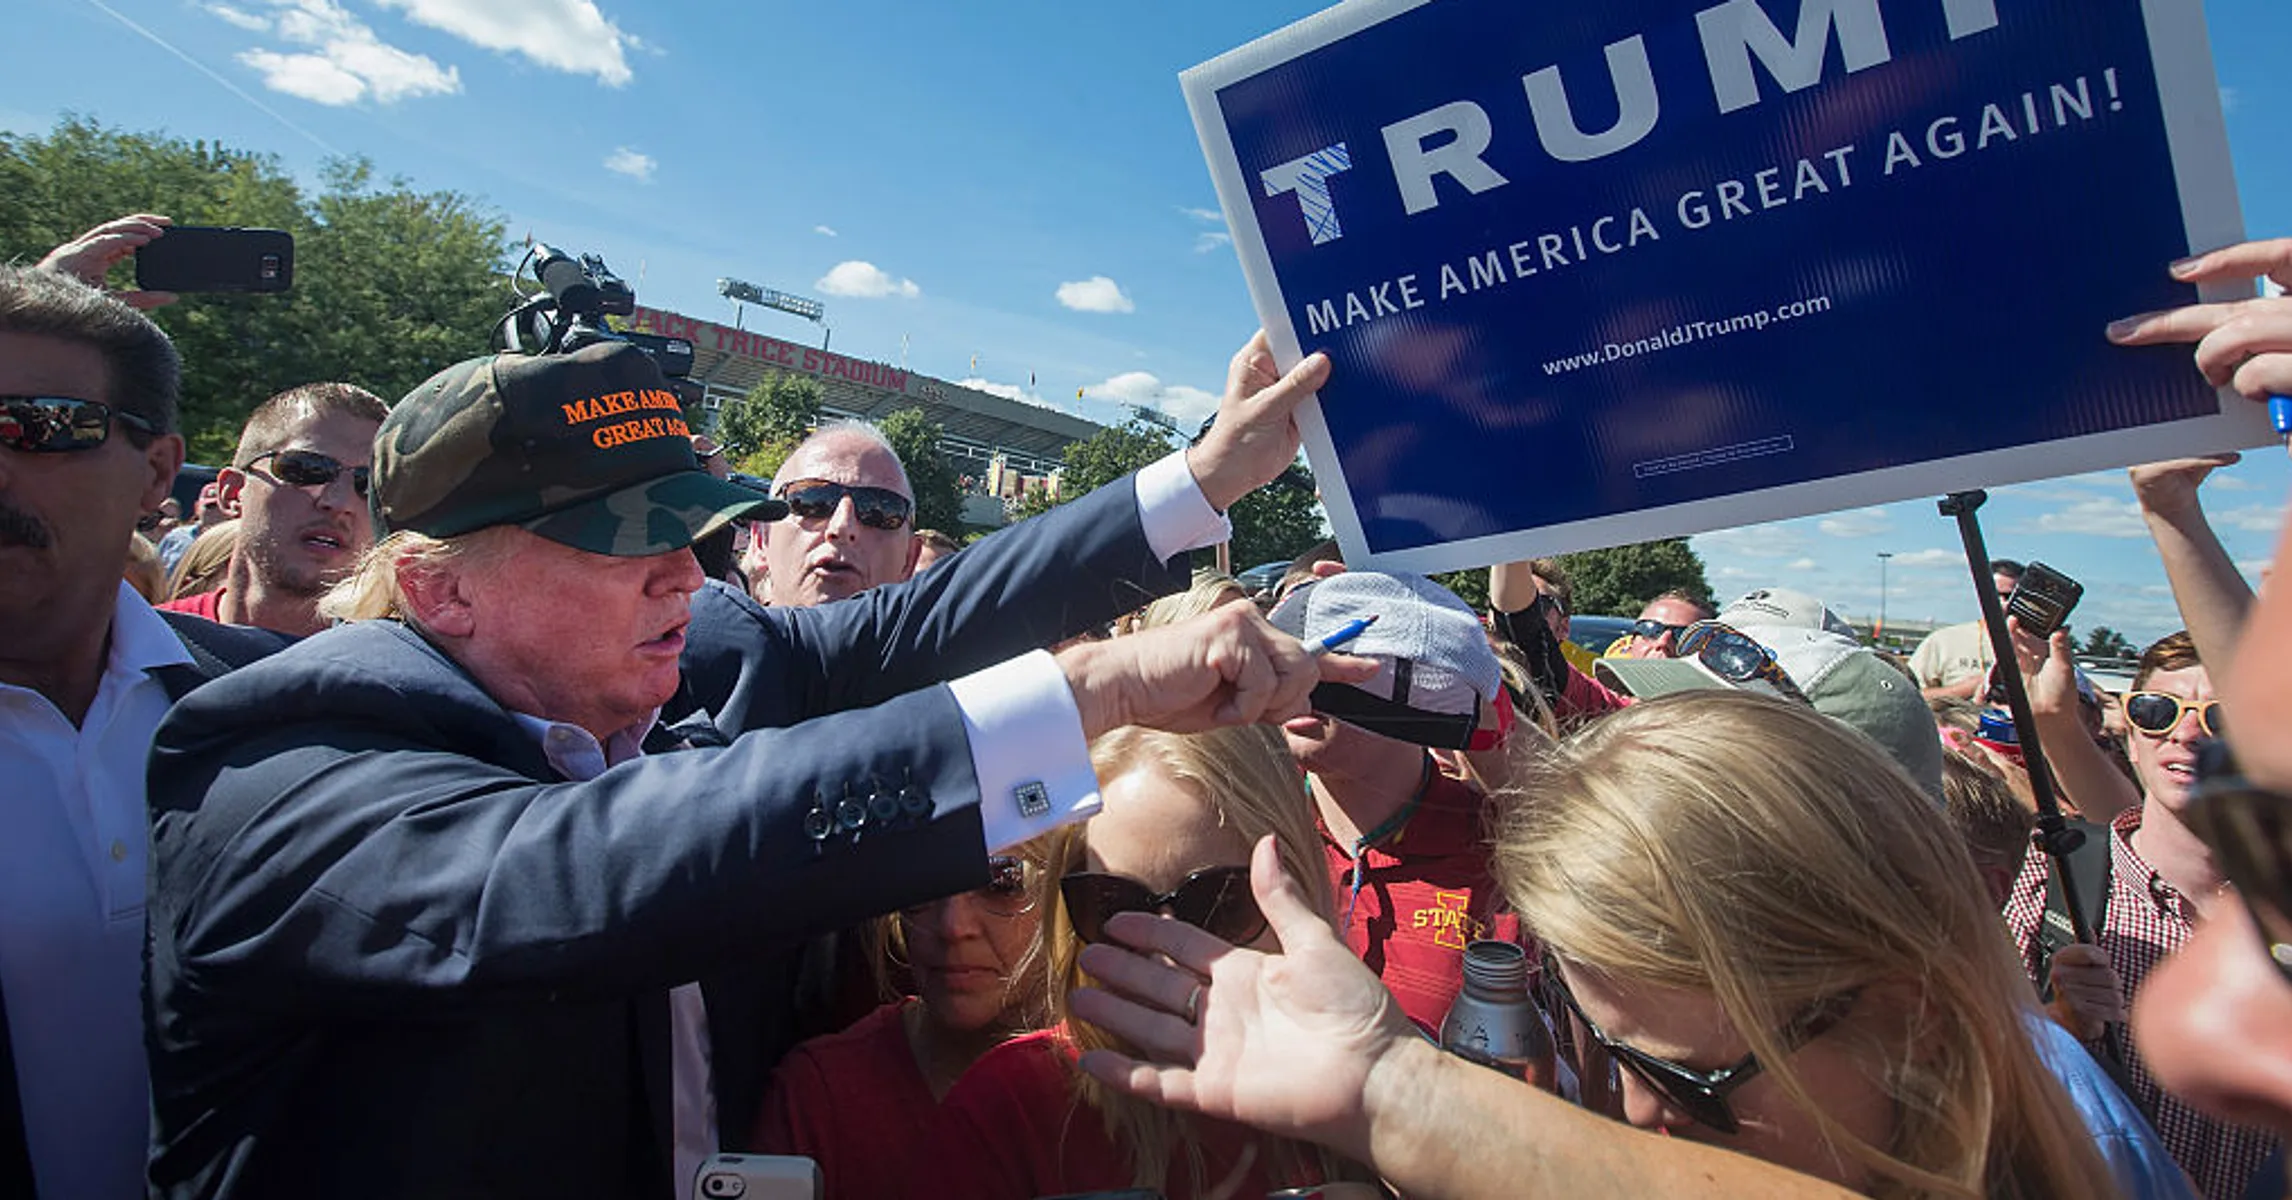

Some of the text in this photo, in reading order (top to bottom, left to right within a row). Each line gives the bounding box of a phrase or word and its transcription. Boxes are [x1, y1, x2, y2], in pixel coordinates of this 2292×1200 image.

[1305, 66, 2123, 336] MAKE AMERICA GREAT AGAIN!
[711, 326, 797, 367] TRICE
[802, 350, 909, 393] STADIUM
[1542, 296, 1831, 376] www.DonaldJTrump.com
[561, 391, 640, 425] MAKE
[592, 416, 665, 449] GREAT
